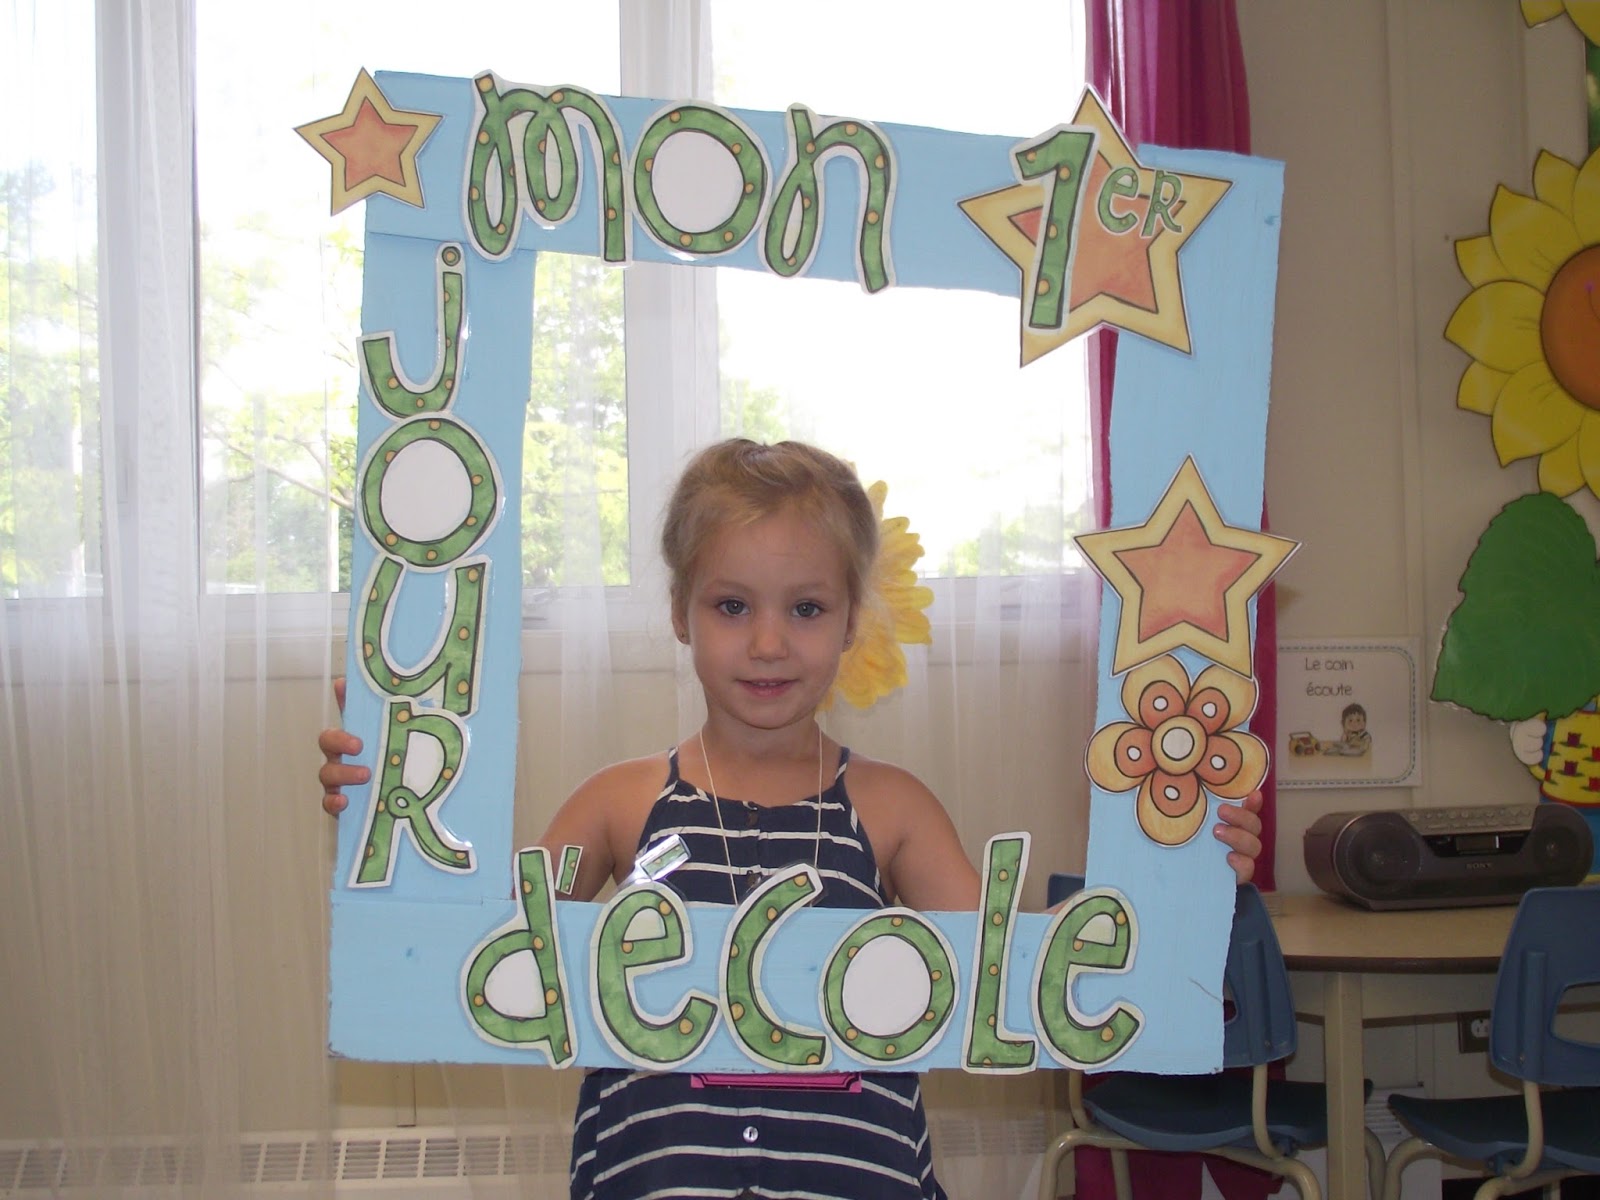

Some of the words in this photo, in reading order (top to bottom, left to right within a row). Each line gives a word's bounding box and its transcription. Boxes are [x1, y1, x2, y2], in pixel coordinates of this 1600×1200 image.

[1305, 658, 1321, 671] Le
[1324, 659, 1355, 671] coin
[1306, 682, 1353, 697] écoute
[1465, 862, 1494, 870] SONY
